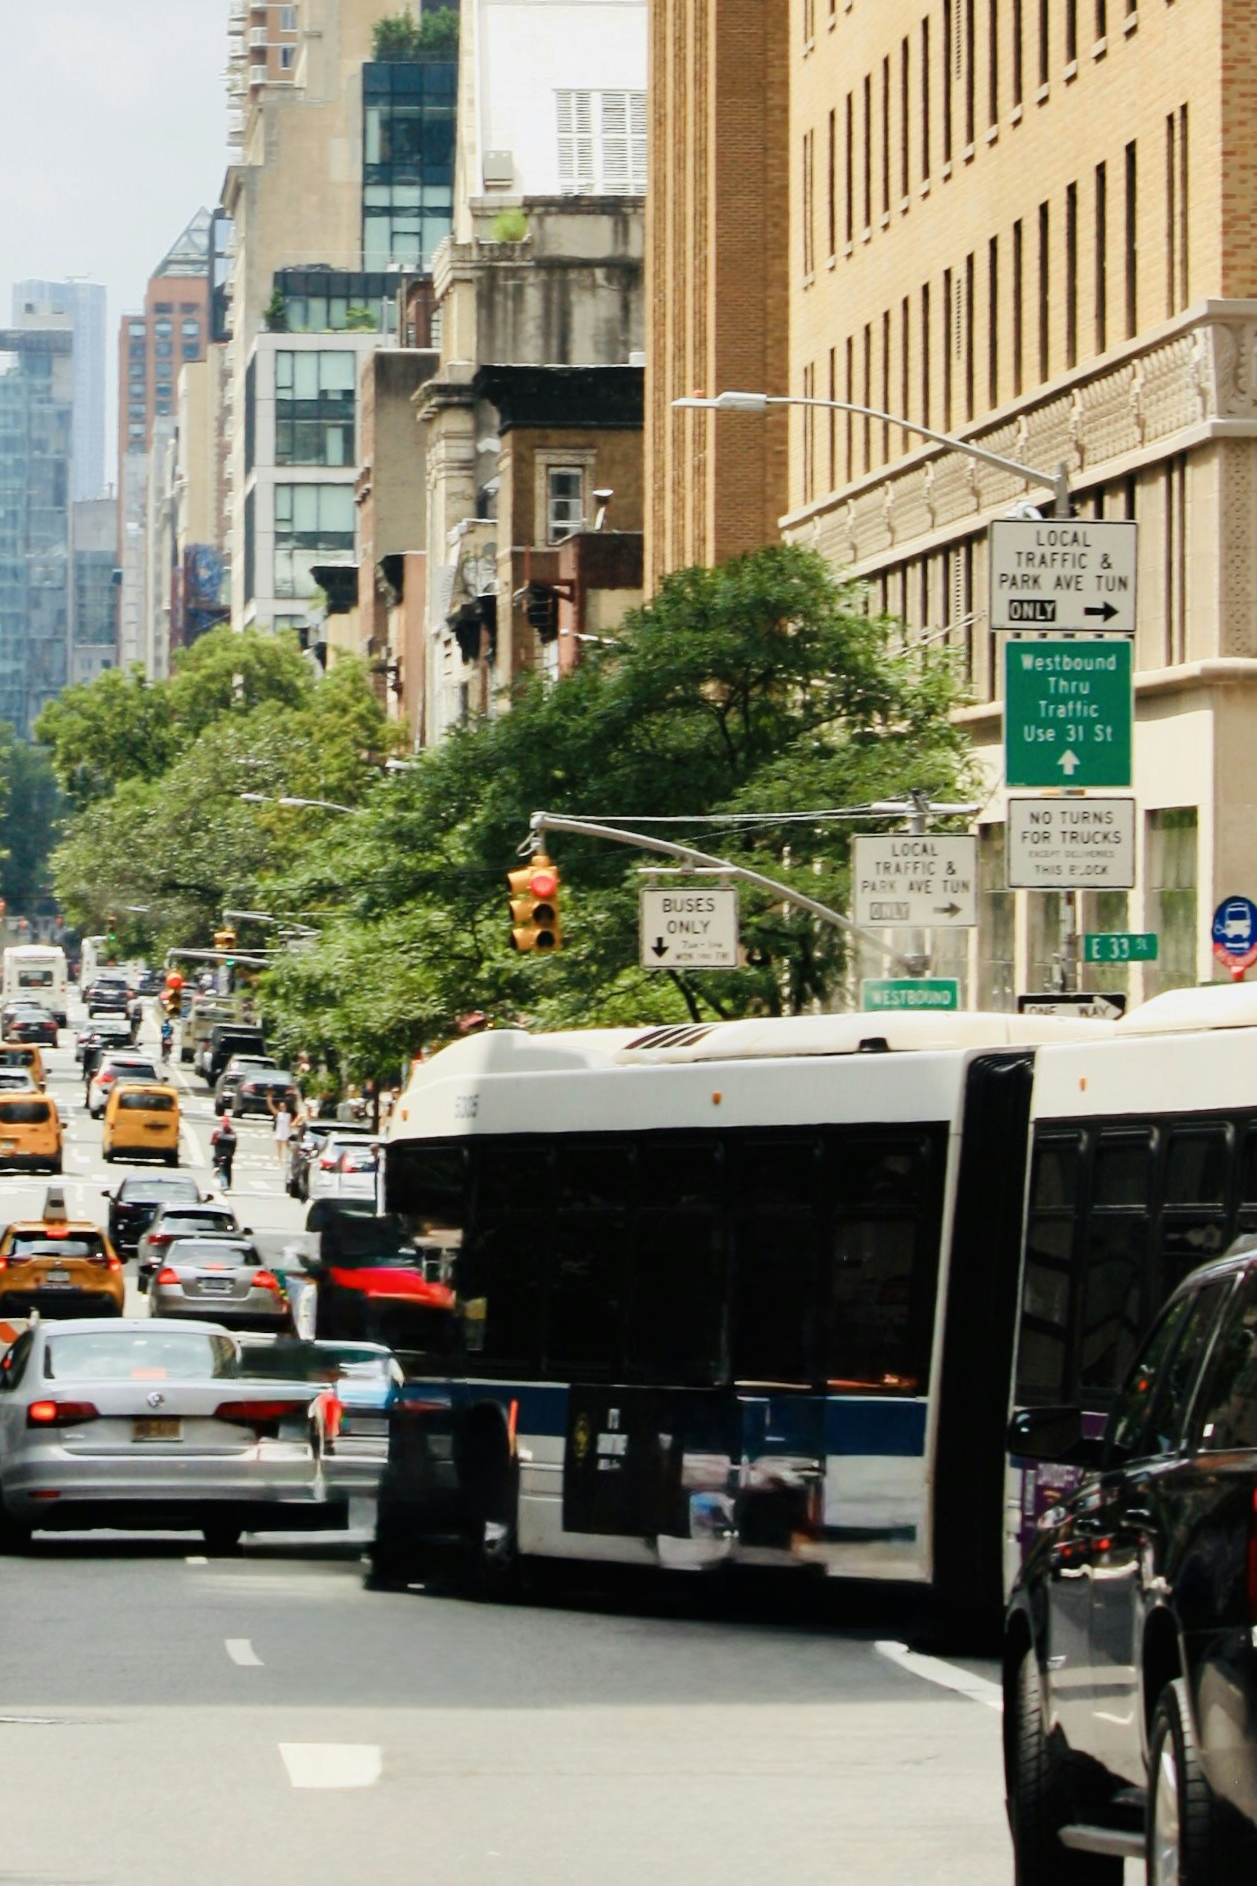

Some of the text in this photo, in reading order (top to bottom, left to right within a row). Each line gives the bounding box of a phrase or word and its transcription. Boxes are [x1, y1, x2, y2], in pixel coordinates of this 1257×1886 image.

[1035, 530, 1091, 548] LOCAL
[1015, 551, 1113, 570] TRAFFIC &
[998, 573, 1129, 592] PARK AVE TUN
[1009, 601, 1056, 620] ONLY
[1020, 654, 1117, 671] Westbound
[1048, 677, 1090, 694] Thru
[1038, 700, 1099, 718] Traffic
[1023, 724, 1113, 742] Use 31 St
[1029, 811, 1115, 825] NO TURNS
[1021, 831, 1122, 845] FOR TRUCKS
[892, 843, 939, 857] LOCAL
[875, 861, 957, 876] TRAFFIC &
[1035, 865, 1062, 876] THIS
[861, 879, 970, 894] PARK AVE TUN
[663, 897, 715, 913] BUSES
[667, 920, 711, 934] ONLY
[1092, 938, 1101, 959] E
[1109, 937, 1130, 959] 33
[871, 989, 952, 1005] WESTBOUND
[1029, 1005, 1110, 1018] ONE WAY
